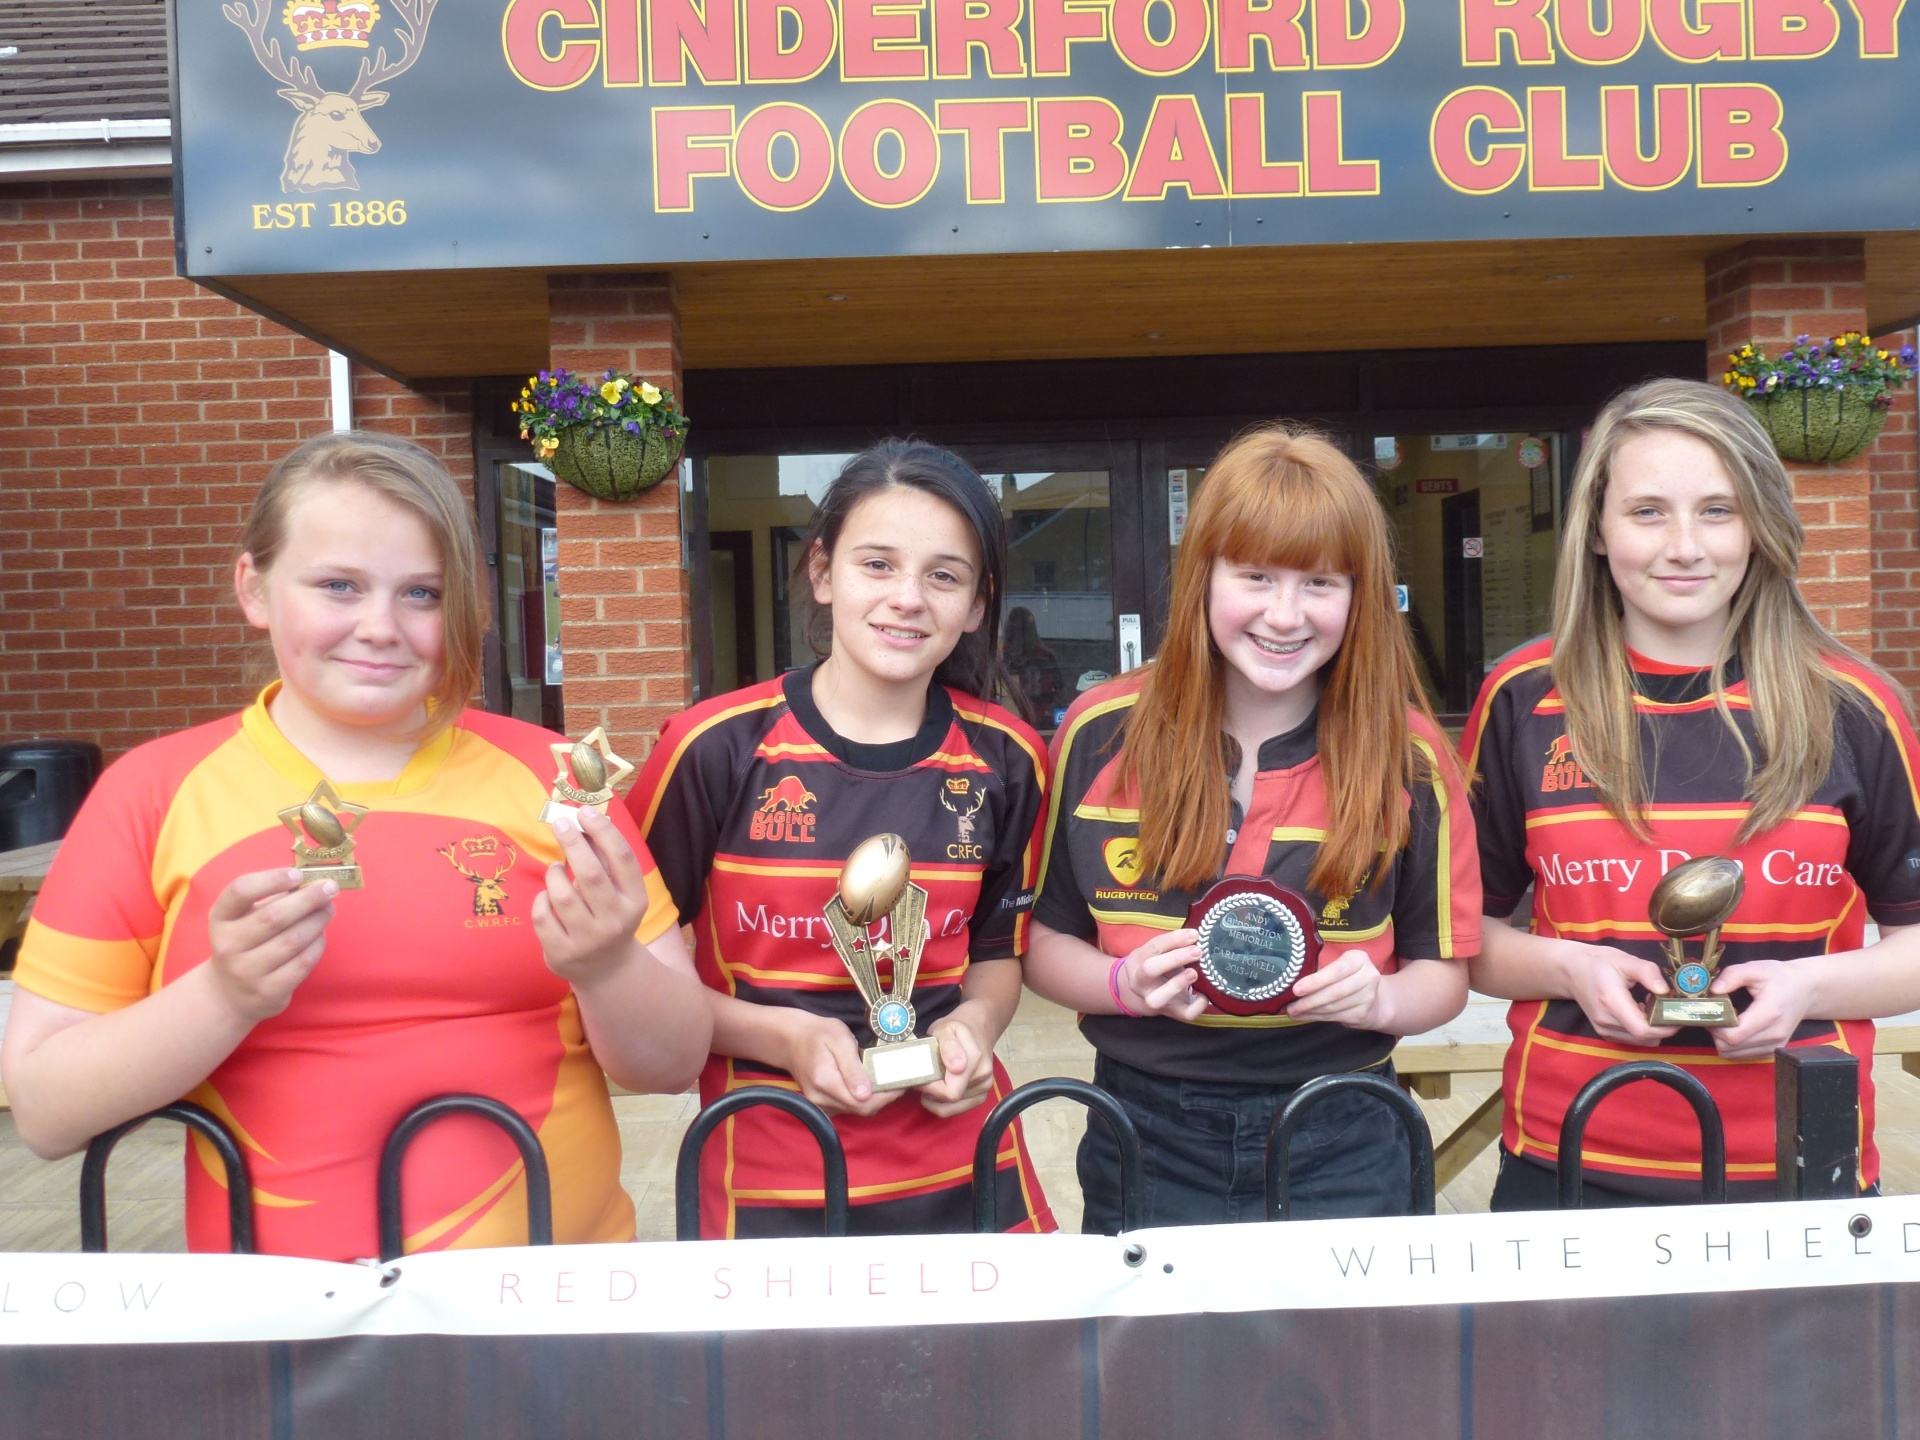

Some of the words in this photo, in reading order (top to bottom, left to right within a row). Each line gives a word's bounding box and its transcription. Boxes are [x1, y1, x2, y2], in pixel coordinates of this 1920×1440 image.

[502, 0, 1405, 92] CINDERFORD
[1460, 0, 1906, 67] RUGBY
[650, 91, 1381, 213] FOOTBALL
[1429, 82, 1790, 196] CLUB
[251, 201, 315, 230] EST
[328, 199, 408, 228] 1886
[563, 786, 602, 802] RUGBY
[749, 820, 816, 843] BULL
[752, 810, 816, 827] RAGING
[946, 843, 983, 860] CRFC
[1538, 852, 1643, 892] Merry
[1761, 848, 1843, 887] Care
[1245, 911, 1271, 926] ANDY
[1228, 929, 1274, 951] MEMORIAL
[1330, 1236, 1583, 1277] WHITE
[499, 1269, 638, 1305] RED
[712, 1260, 1000, 1301] SHIELD
